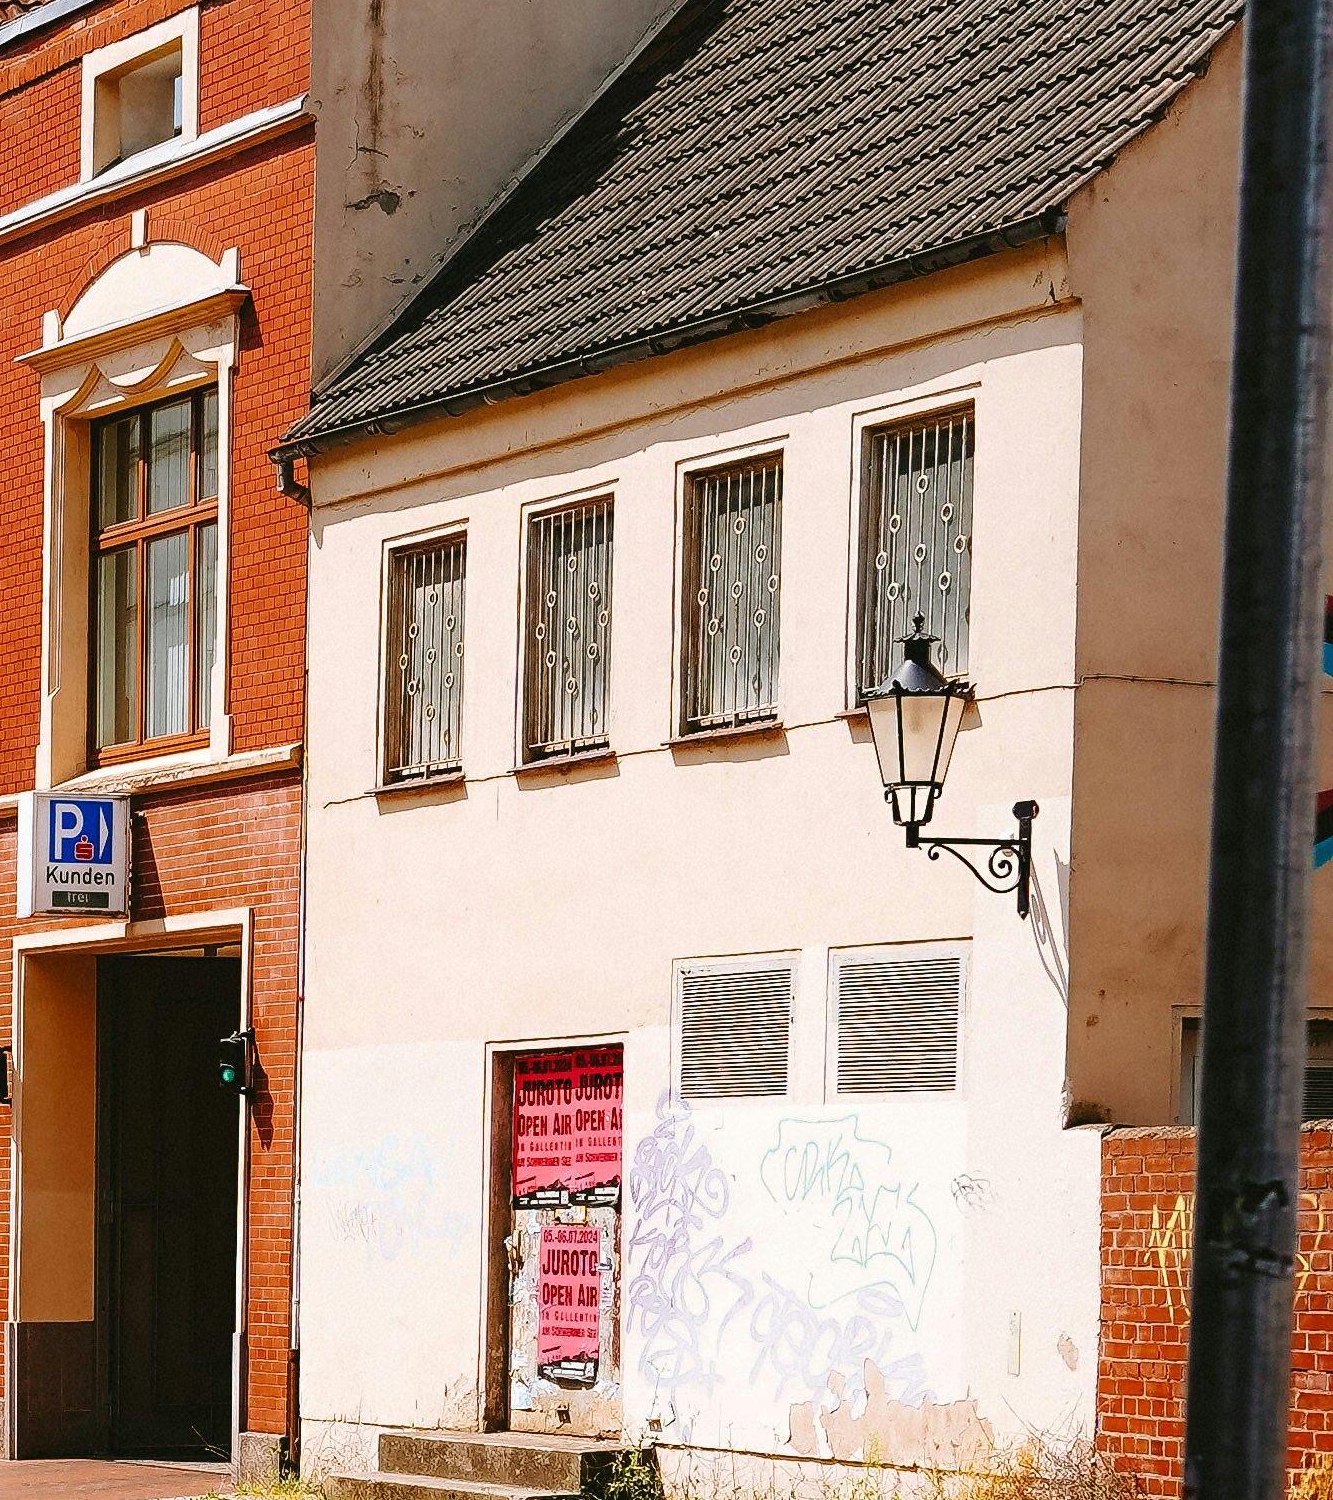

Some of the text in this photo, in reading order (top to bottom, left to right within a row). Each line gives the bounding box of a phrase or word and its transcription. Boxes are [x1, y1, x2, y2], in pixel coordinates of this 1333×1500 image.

[54, 803, 84, 859] P
[45, 866, 115, 885] Kunden
[517, 1078, 573, 1107] JUROTO
[517, 1112, 573, 1137] OPEN AIR
[575, 1108, 606, 1132] OPEN
[542, 1248, 598, 1277] JUROTO
[542, 1282, 598, 1307] OPEN AIR
